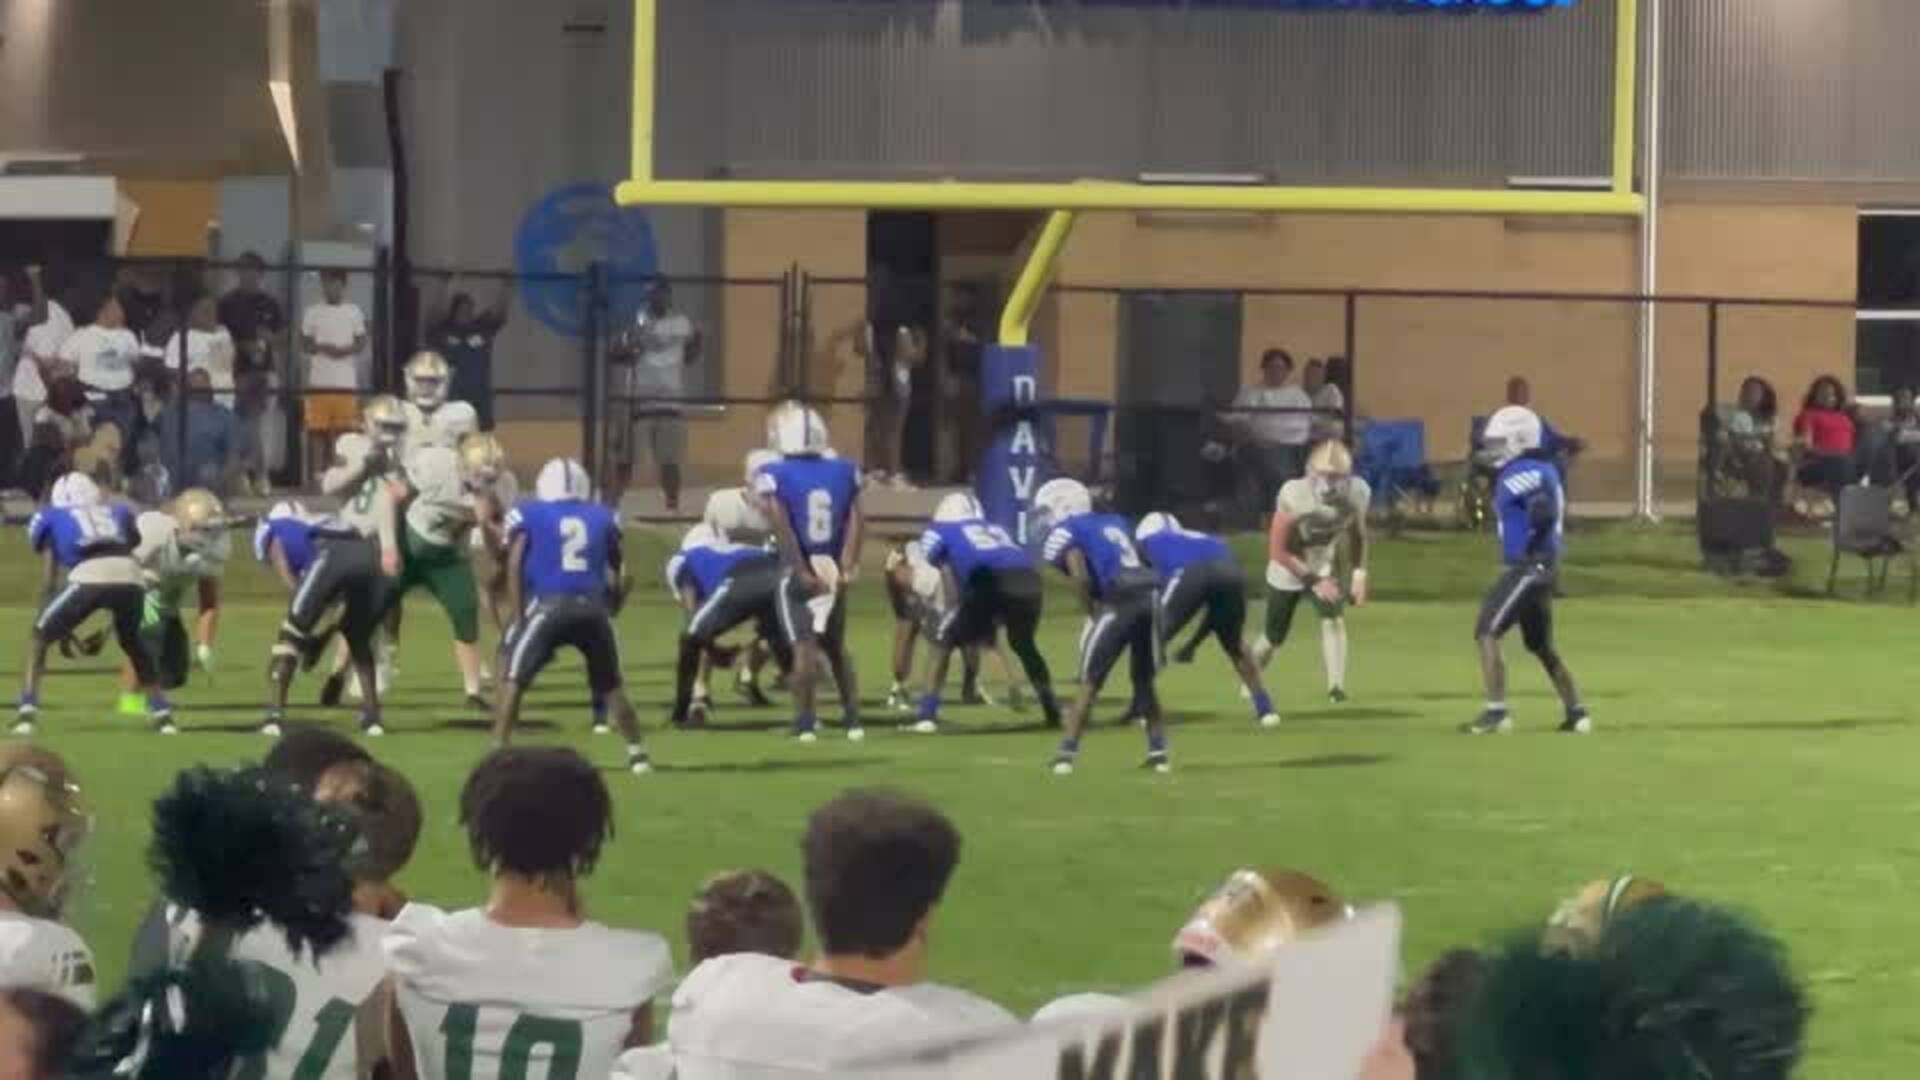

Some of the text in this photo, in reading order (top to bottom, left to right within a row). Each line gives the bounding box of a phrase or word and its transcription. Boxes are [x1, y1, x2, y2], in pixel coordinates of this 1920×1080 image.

[808, 489, 832, 541] 6
[560, 516, 588, 572] 2
[1103, 526, 1140, 568] 3
